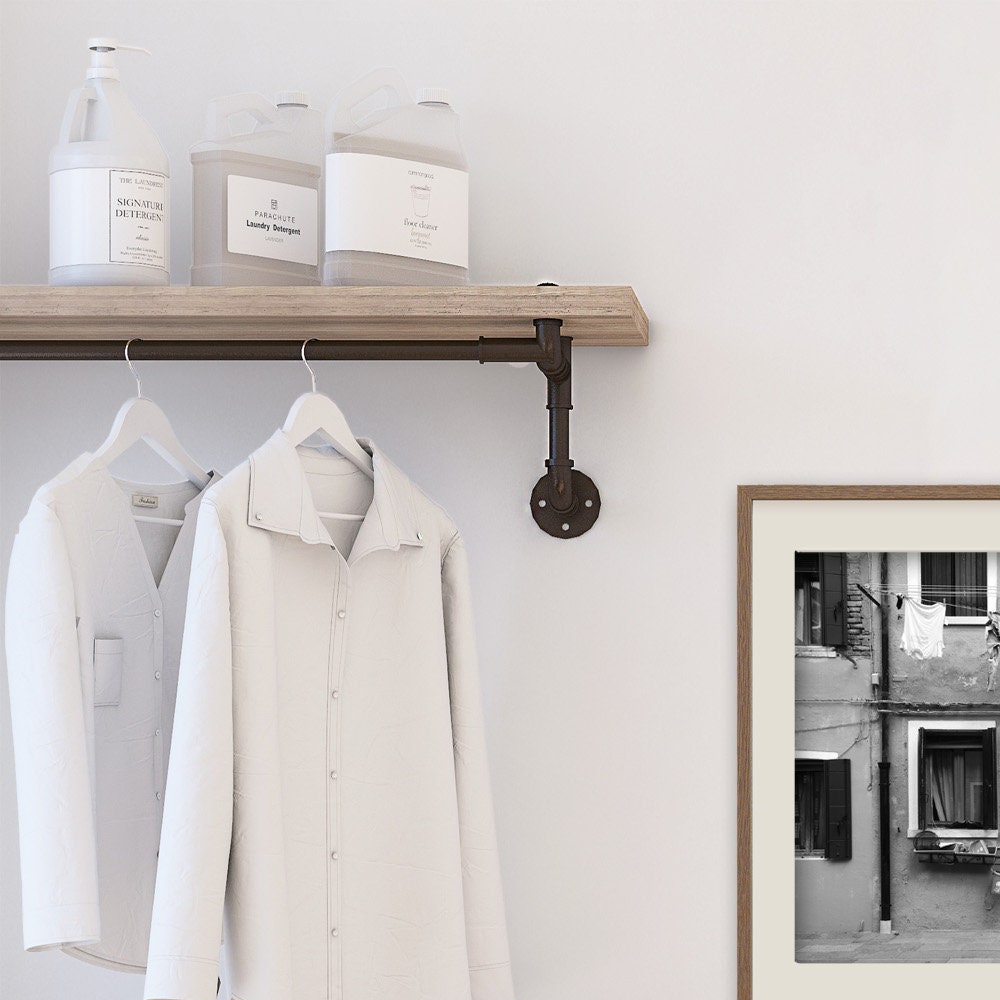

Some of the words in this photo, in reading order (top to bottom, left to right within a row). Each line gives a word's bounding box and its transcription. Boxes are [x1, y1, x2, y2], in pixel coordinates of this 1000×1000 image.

[116, 209, 163, 222] DETERGEN
[254, 210, 296, 224] PARACHUTE
[246, 219, 270, 232] Laundry
[272, 224, 301, 236] Detergent
